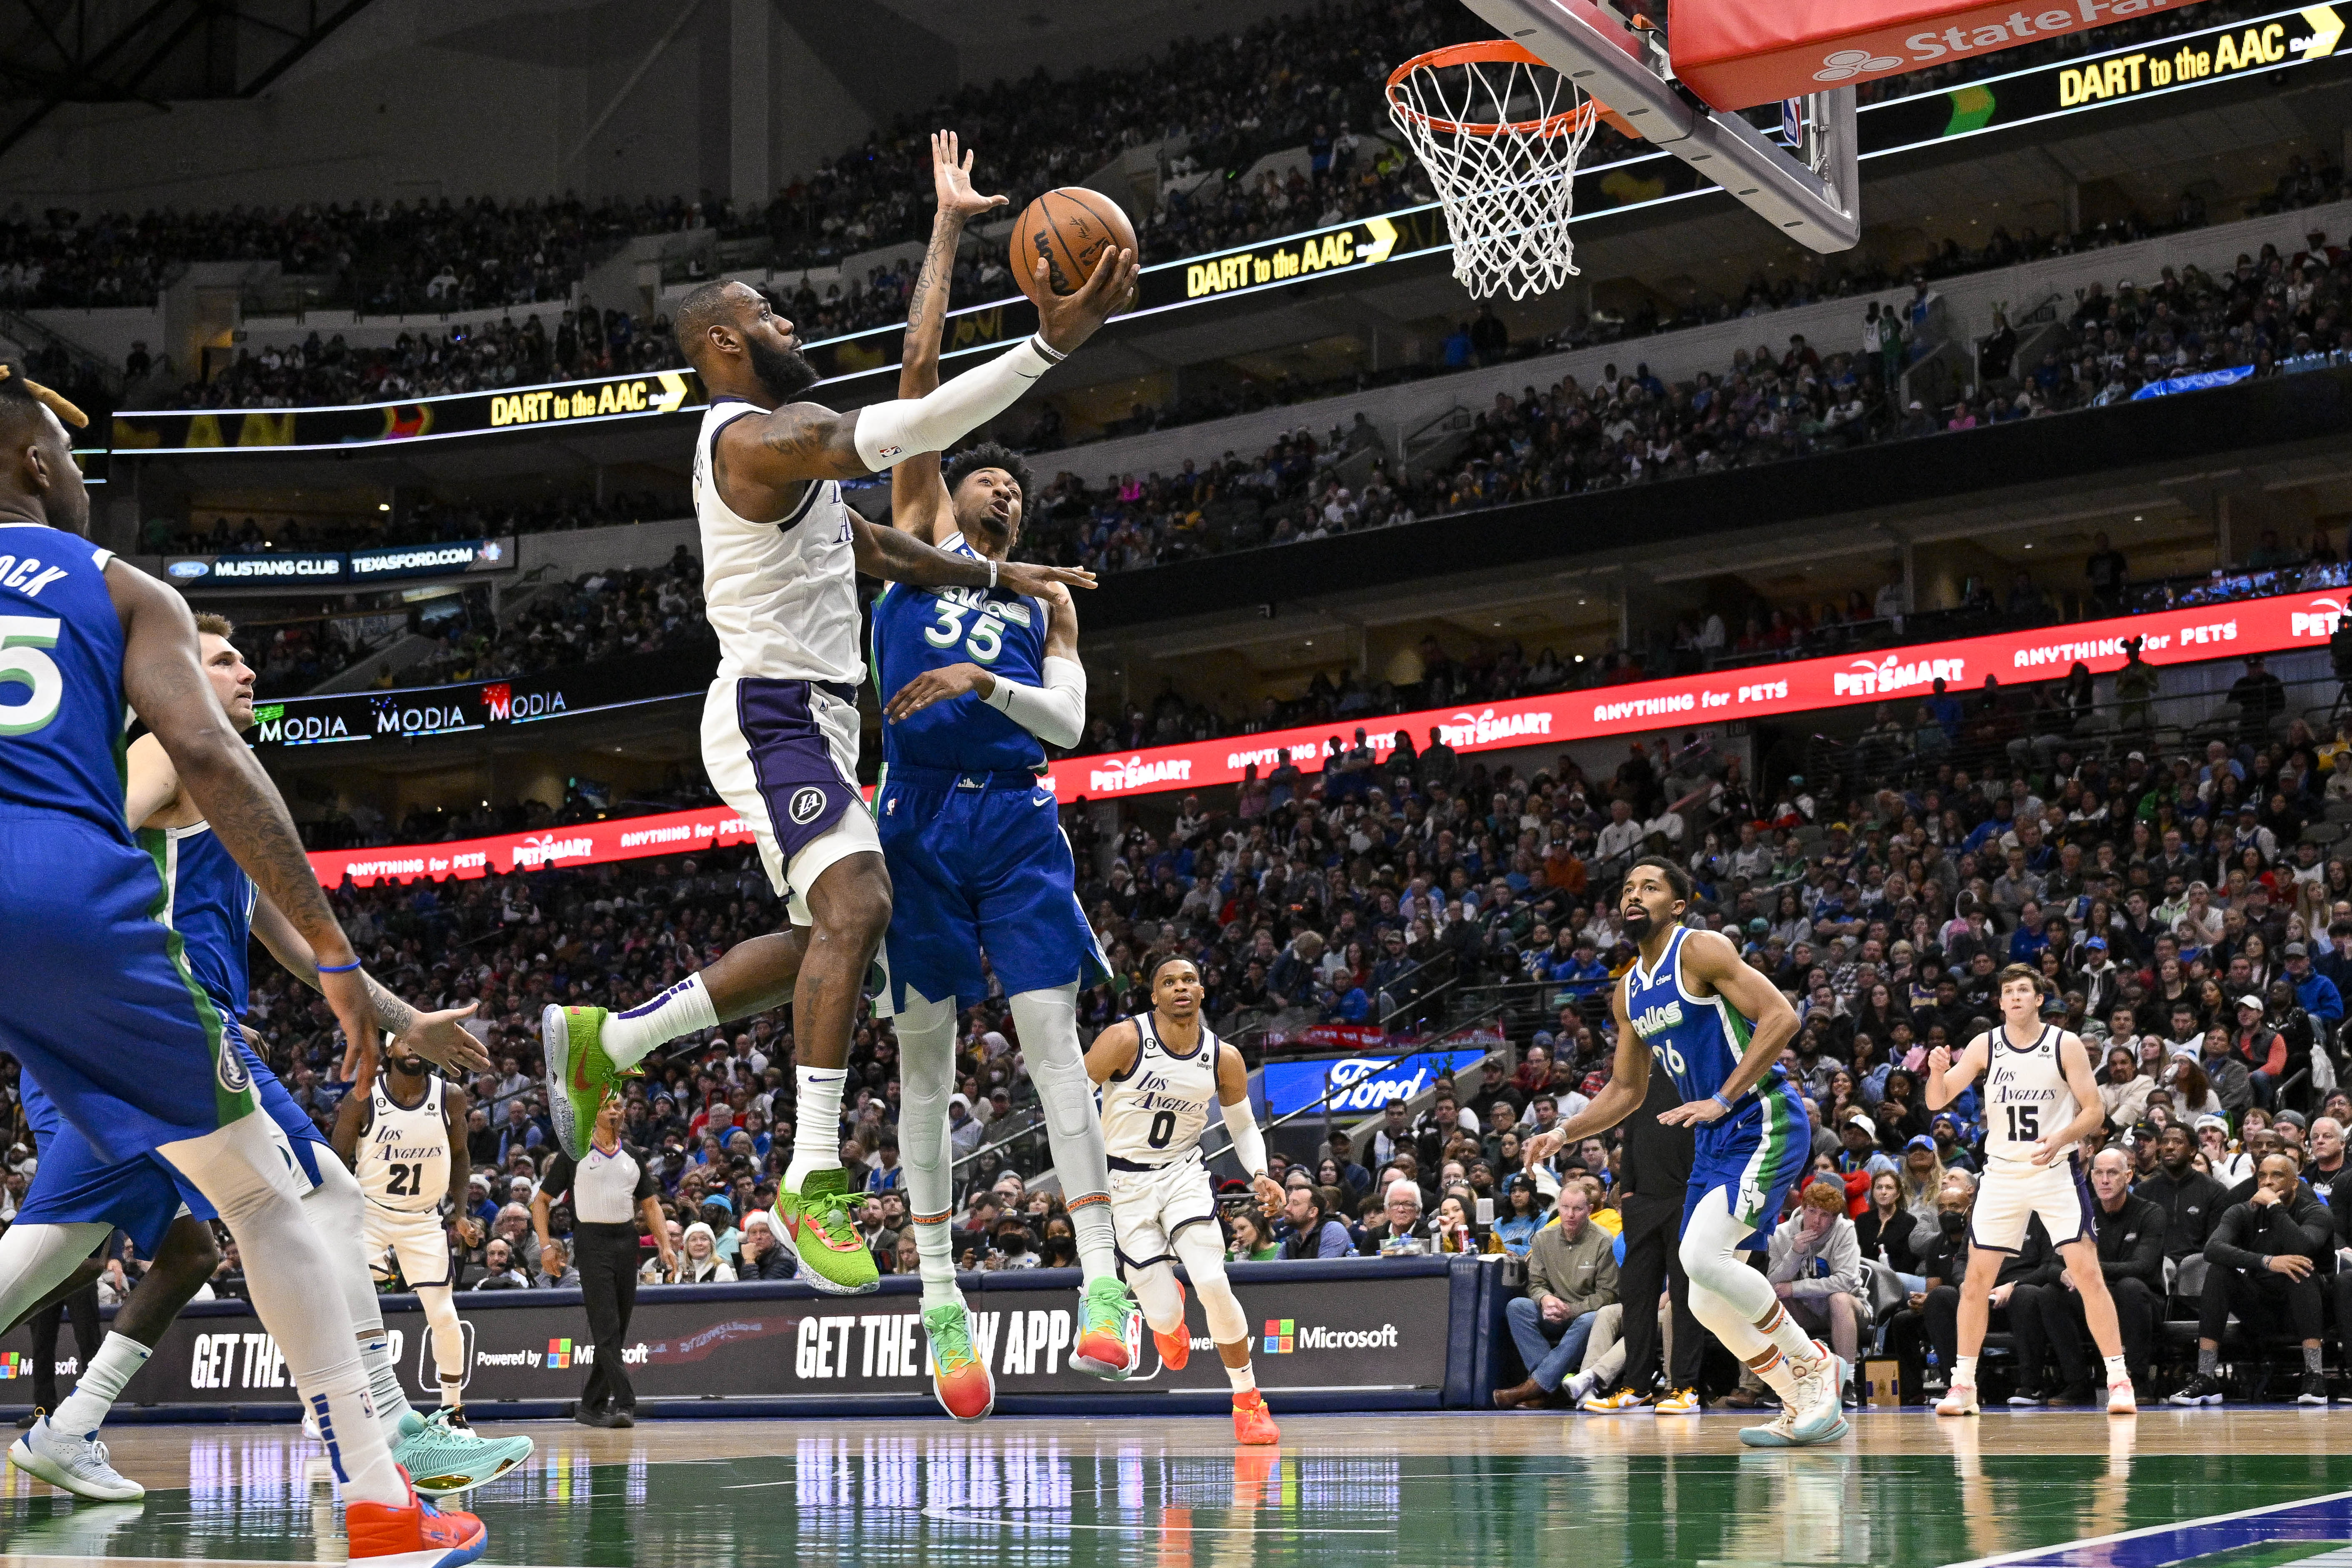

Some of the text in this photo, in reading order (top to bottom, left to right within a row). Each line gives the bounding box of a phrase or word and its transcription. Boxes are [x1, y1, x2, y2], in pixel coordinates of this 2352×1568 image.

[1905, 0, 2167, 61] State Fa
[2060, 24, 2285, 107] DART to the AAC
[1187, 254, 1252, 298] DART
[1254, 256, 1271, 284] to
[1273, 248, 1299, 279] the
[1301, 231, 1354, 273] AAC
[491, 392, 553, 426] DART
[554, 394, 569, 419] to
[572, 390, 596, 417] the
[598, 381, 648, 414] AAC
[215, 560, 295, 576] MUSTANG
[296, 560, 340, 575] CLUB
[352, 547, 473, 573] TEXASFORD.COM
[924, 599, 1006, 664] 35
[2014, 637, 2127, 668] ANYTHING
[2181, 623, 2237, 646] PETS
[1834, 658, 1964, 695] PETSMART
[489, 691, 567, 721] MODIA
[1593, 680, 1788, 722] ANYTHING for PETS
[259, 715, 348, 743] MODIA
[378, 705, 465, 733] MODIA
[1439, 712, 1552, 747] PETSMART
[1228, 743, 1316, 769] ANYTNG
[1355, 732, 1396, 751] ETS
[1090, 758, 1192, 791] PETSMART
[797, 793, 820, 818] LA
[621, 818, 752, 848] ANYTHING for PET
[346, 850, 487, 877] ANYTHING for PETS
[513, 836, 593, 865] PETSMART
[1656, 973, 1672, 986] chime
[1196, 1062, 1212, 1070] bibigo
[1652, 1039, 1686, 1077] 26
[1321, 1058, 1426, 1110] Ford
[1992, 1085, 2057, 1103] ANGELES
[1148, 1110, 1177, 1149] 0
[2007, 1105, 2039, 1141] 15
[373, 1144, 443, 1161] ANGELES
[386, 1163, 423, 1196] 21
[796, 1315, 857, 1379] GET
[860, 1314, 920, 1377] THE
[1003, 1310, 1071, 1375] APP
[1299, 1323, 1398, 1348] Microsoft
[20, 1356, 79, 1375] Msoft
[191, 1333, 286, 1389] GET THE
[477, 1350, 542, 1368] Powered by
[574, 1343, 649, 1365] Misoft
